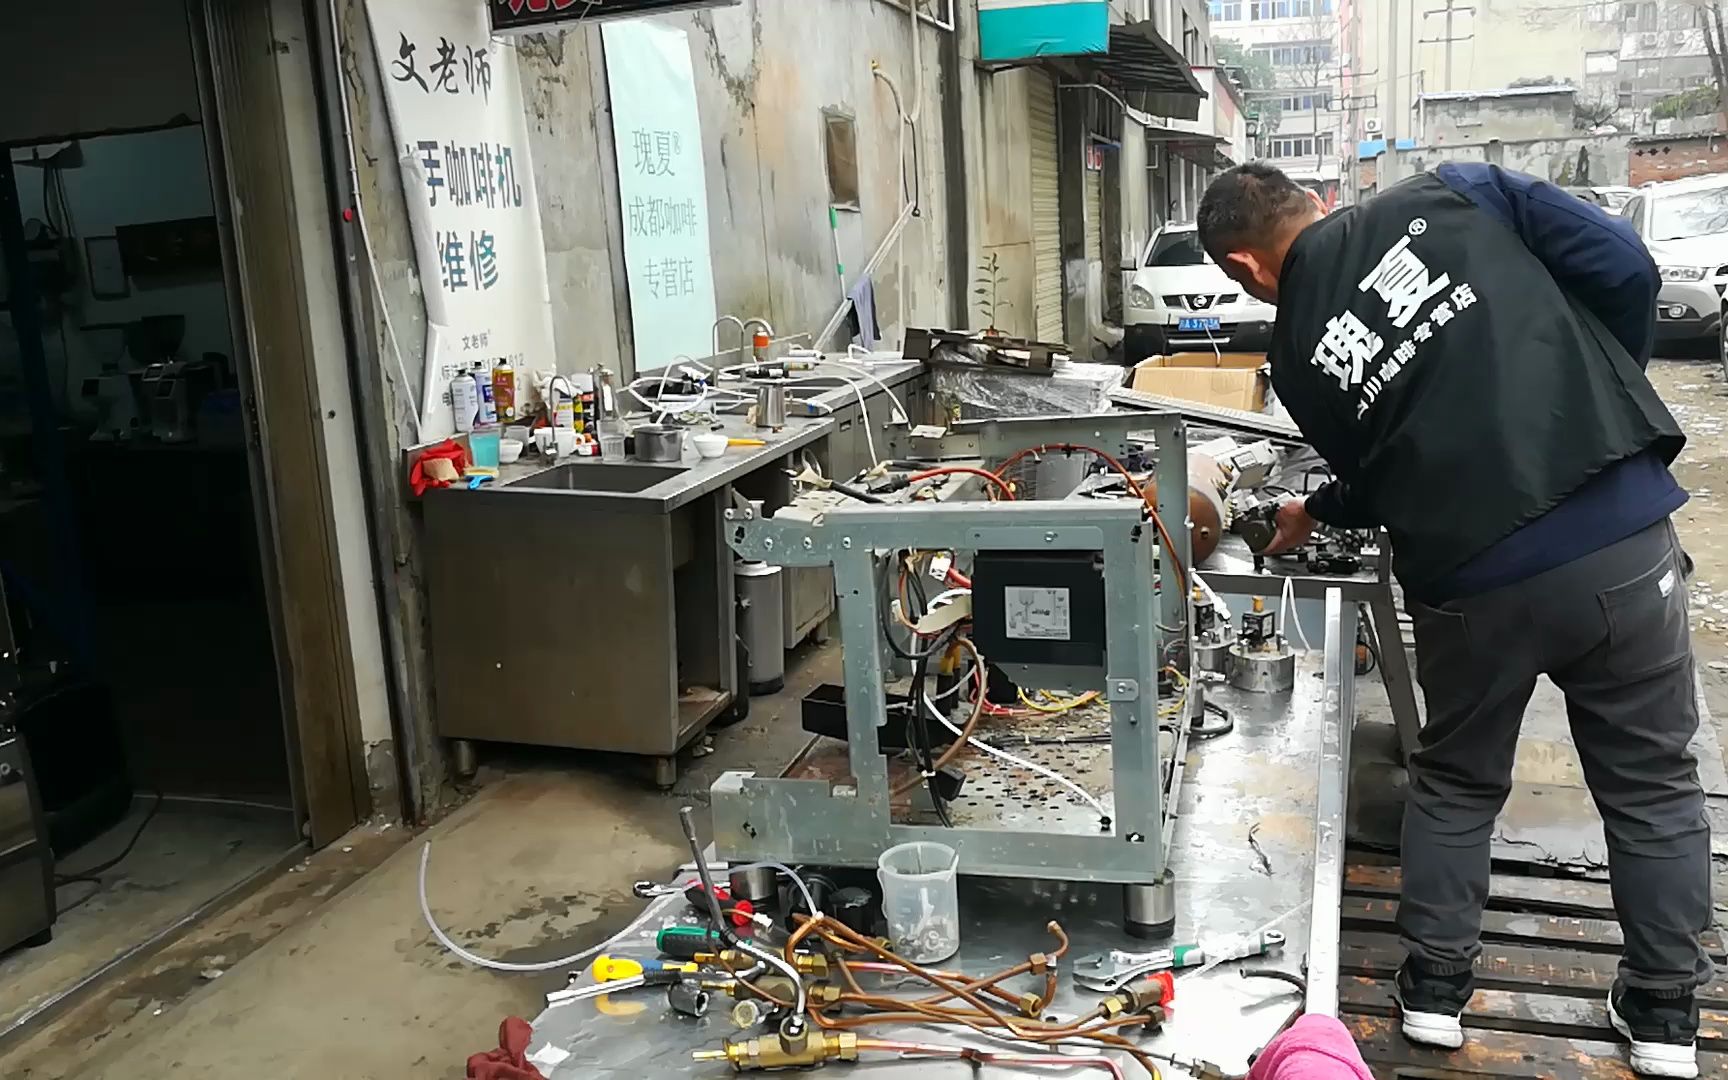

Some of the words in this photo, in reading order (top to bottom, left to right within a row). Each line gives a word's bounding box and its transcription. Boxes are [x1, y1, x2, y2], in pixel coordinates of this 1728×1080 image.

[391, 31, 492, 105] 文老师
[405, 140, 522, 209] 手咖啡机
[628, 195, 698, 238] 成都咖啡
[436, 229, 500, 293] 维修
[643, 256, 695, 300] 专营店
